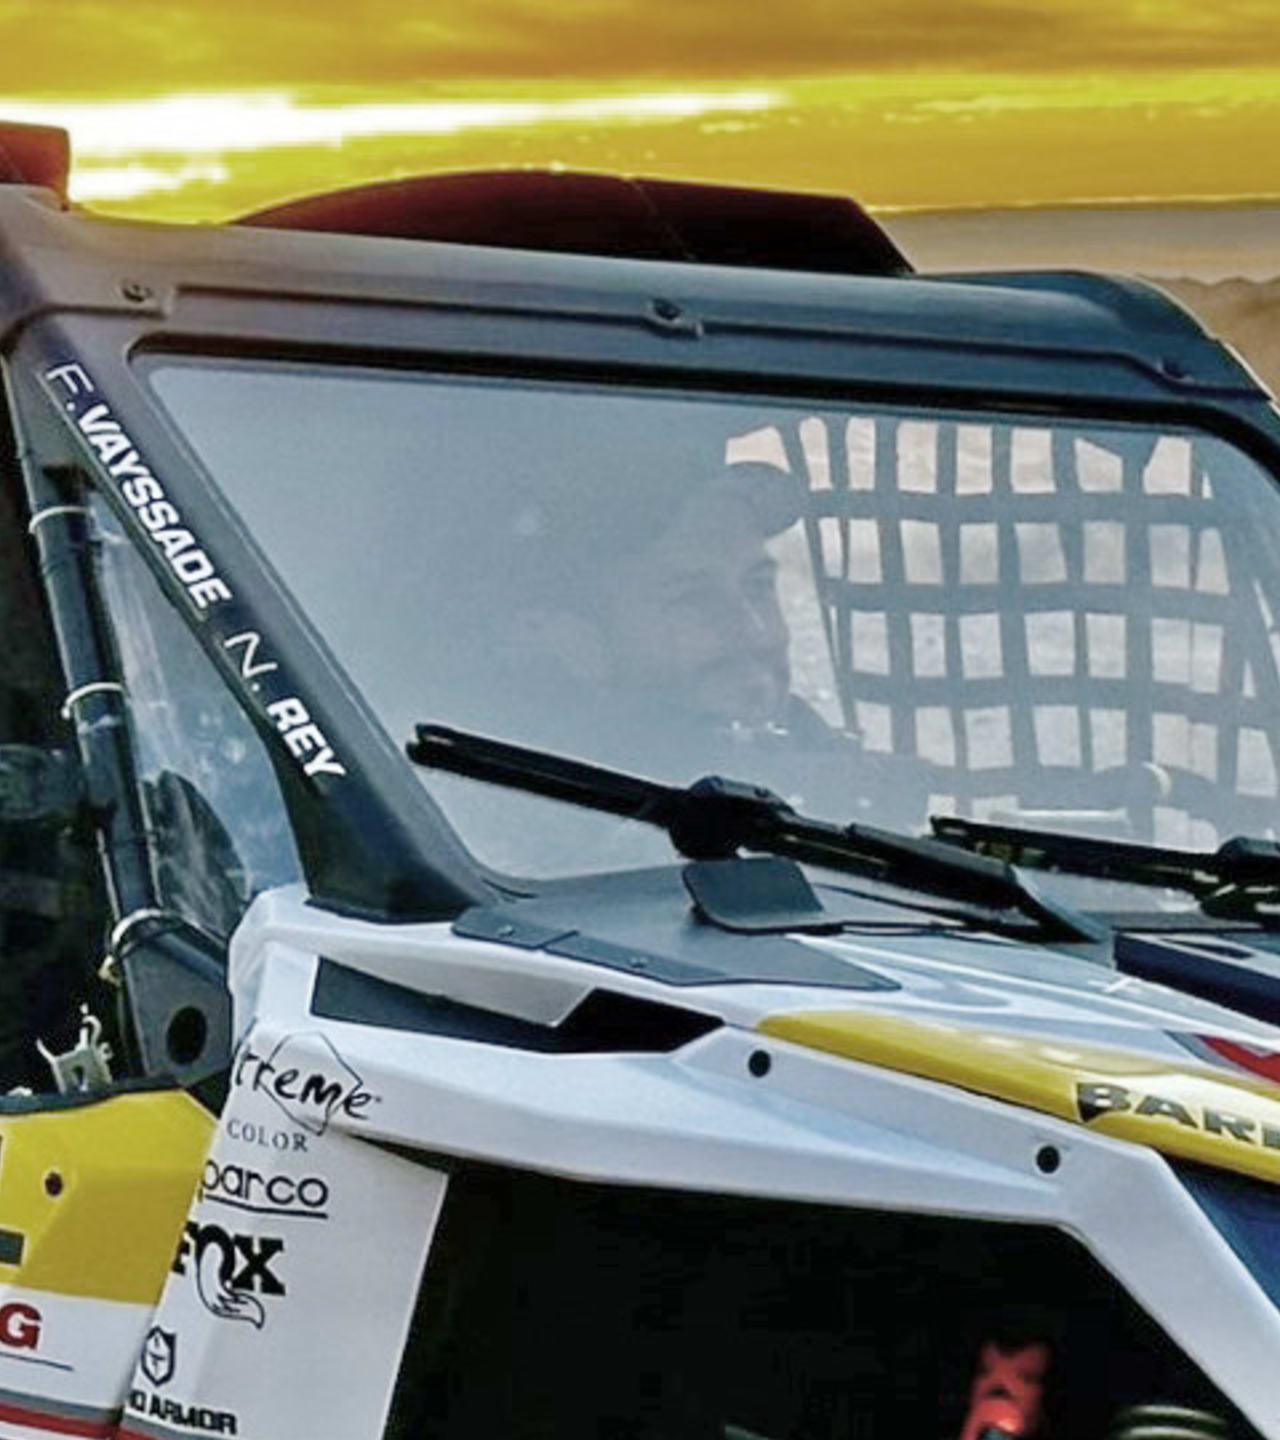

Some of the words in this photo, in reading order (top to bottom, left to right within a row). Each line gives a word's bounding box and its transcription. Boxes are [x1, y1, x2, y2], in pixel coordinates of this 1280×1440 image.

[266, 697, 347, 777] REY
[233, 1042, 372, 1120] treme
[226, 1118, 309, 1152] COLOR
[199, 1159, 330, 1207] parco
[149, 1391, 238, 1436] ARMOR
